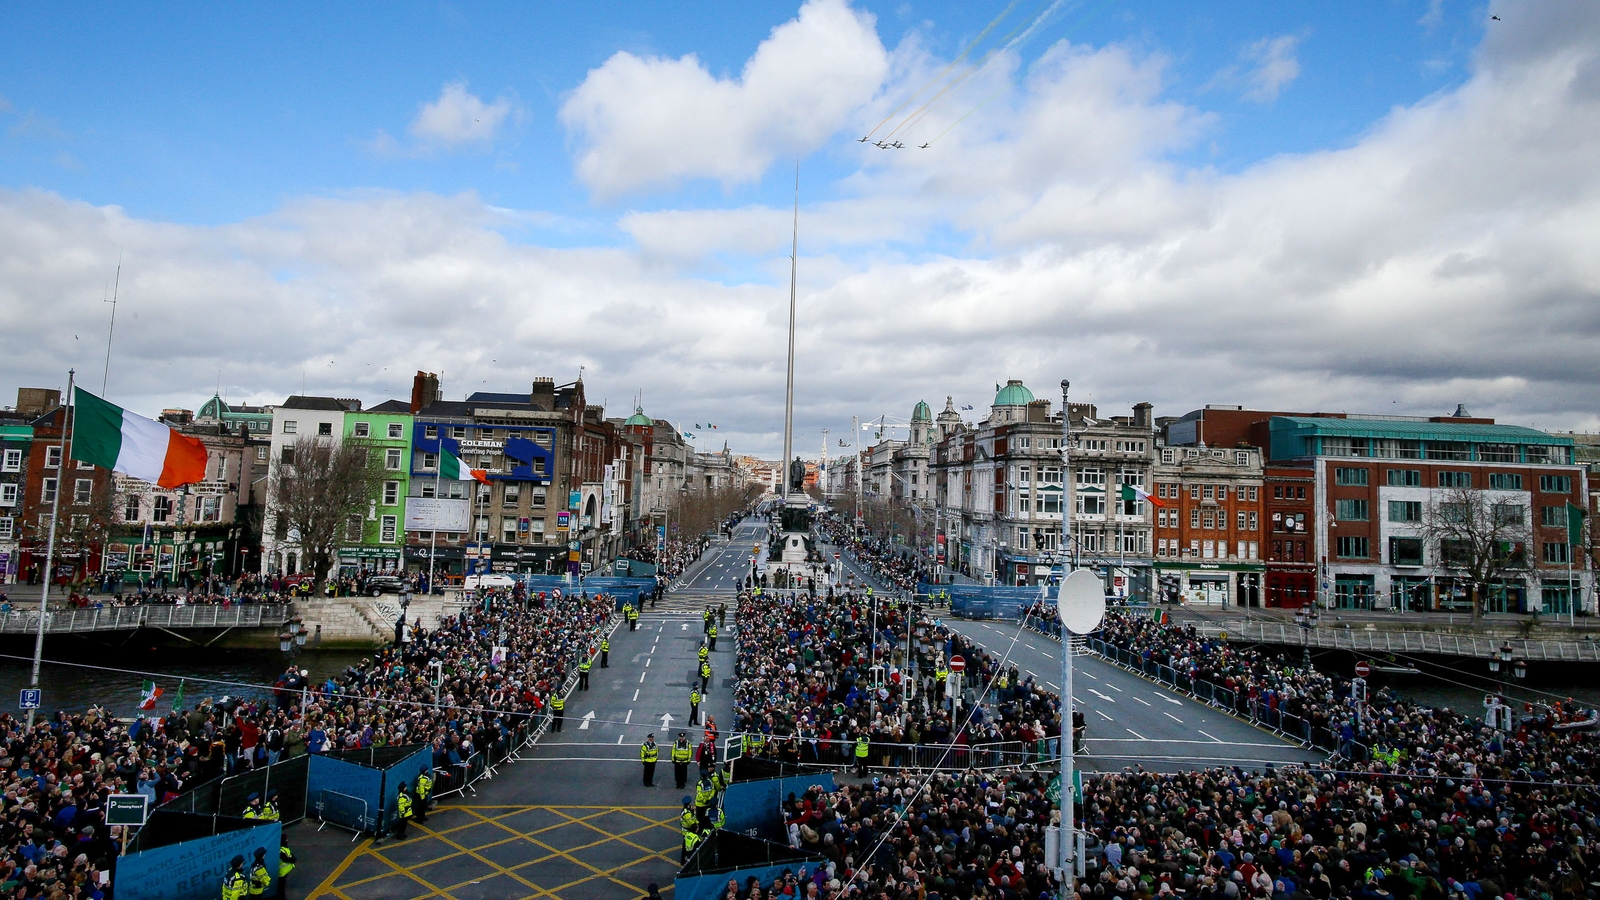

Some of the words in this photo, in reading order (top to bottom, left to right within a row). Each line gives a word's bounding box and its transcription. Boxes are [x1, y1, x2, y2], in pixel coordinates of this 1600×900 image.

[460, 447, 485, 455] Connecting
[28, 692, 34, 700] P
[199, 844, 207, 853] H
[144, 860, 198, 891] PROVISIONAL
[203, 835, 256, 865] GOVERNMENT
